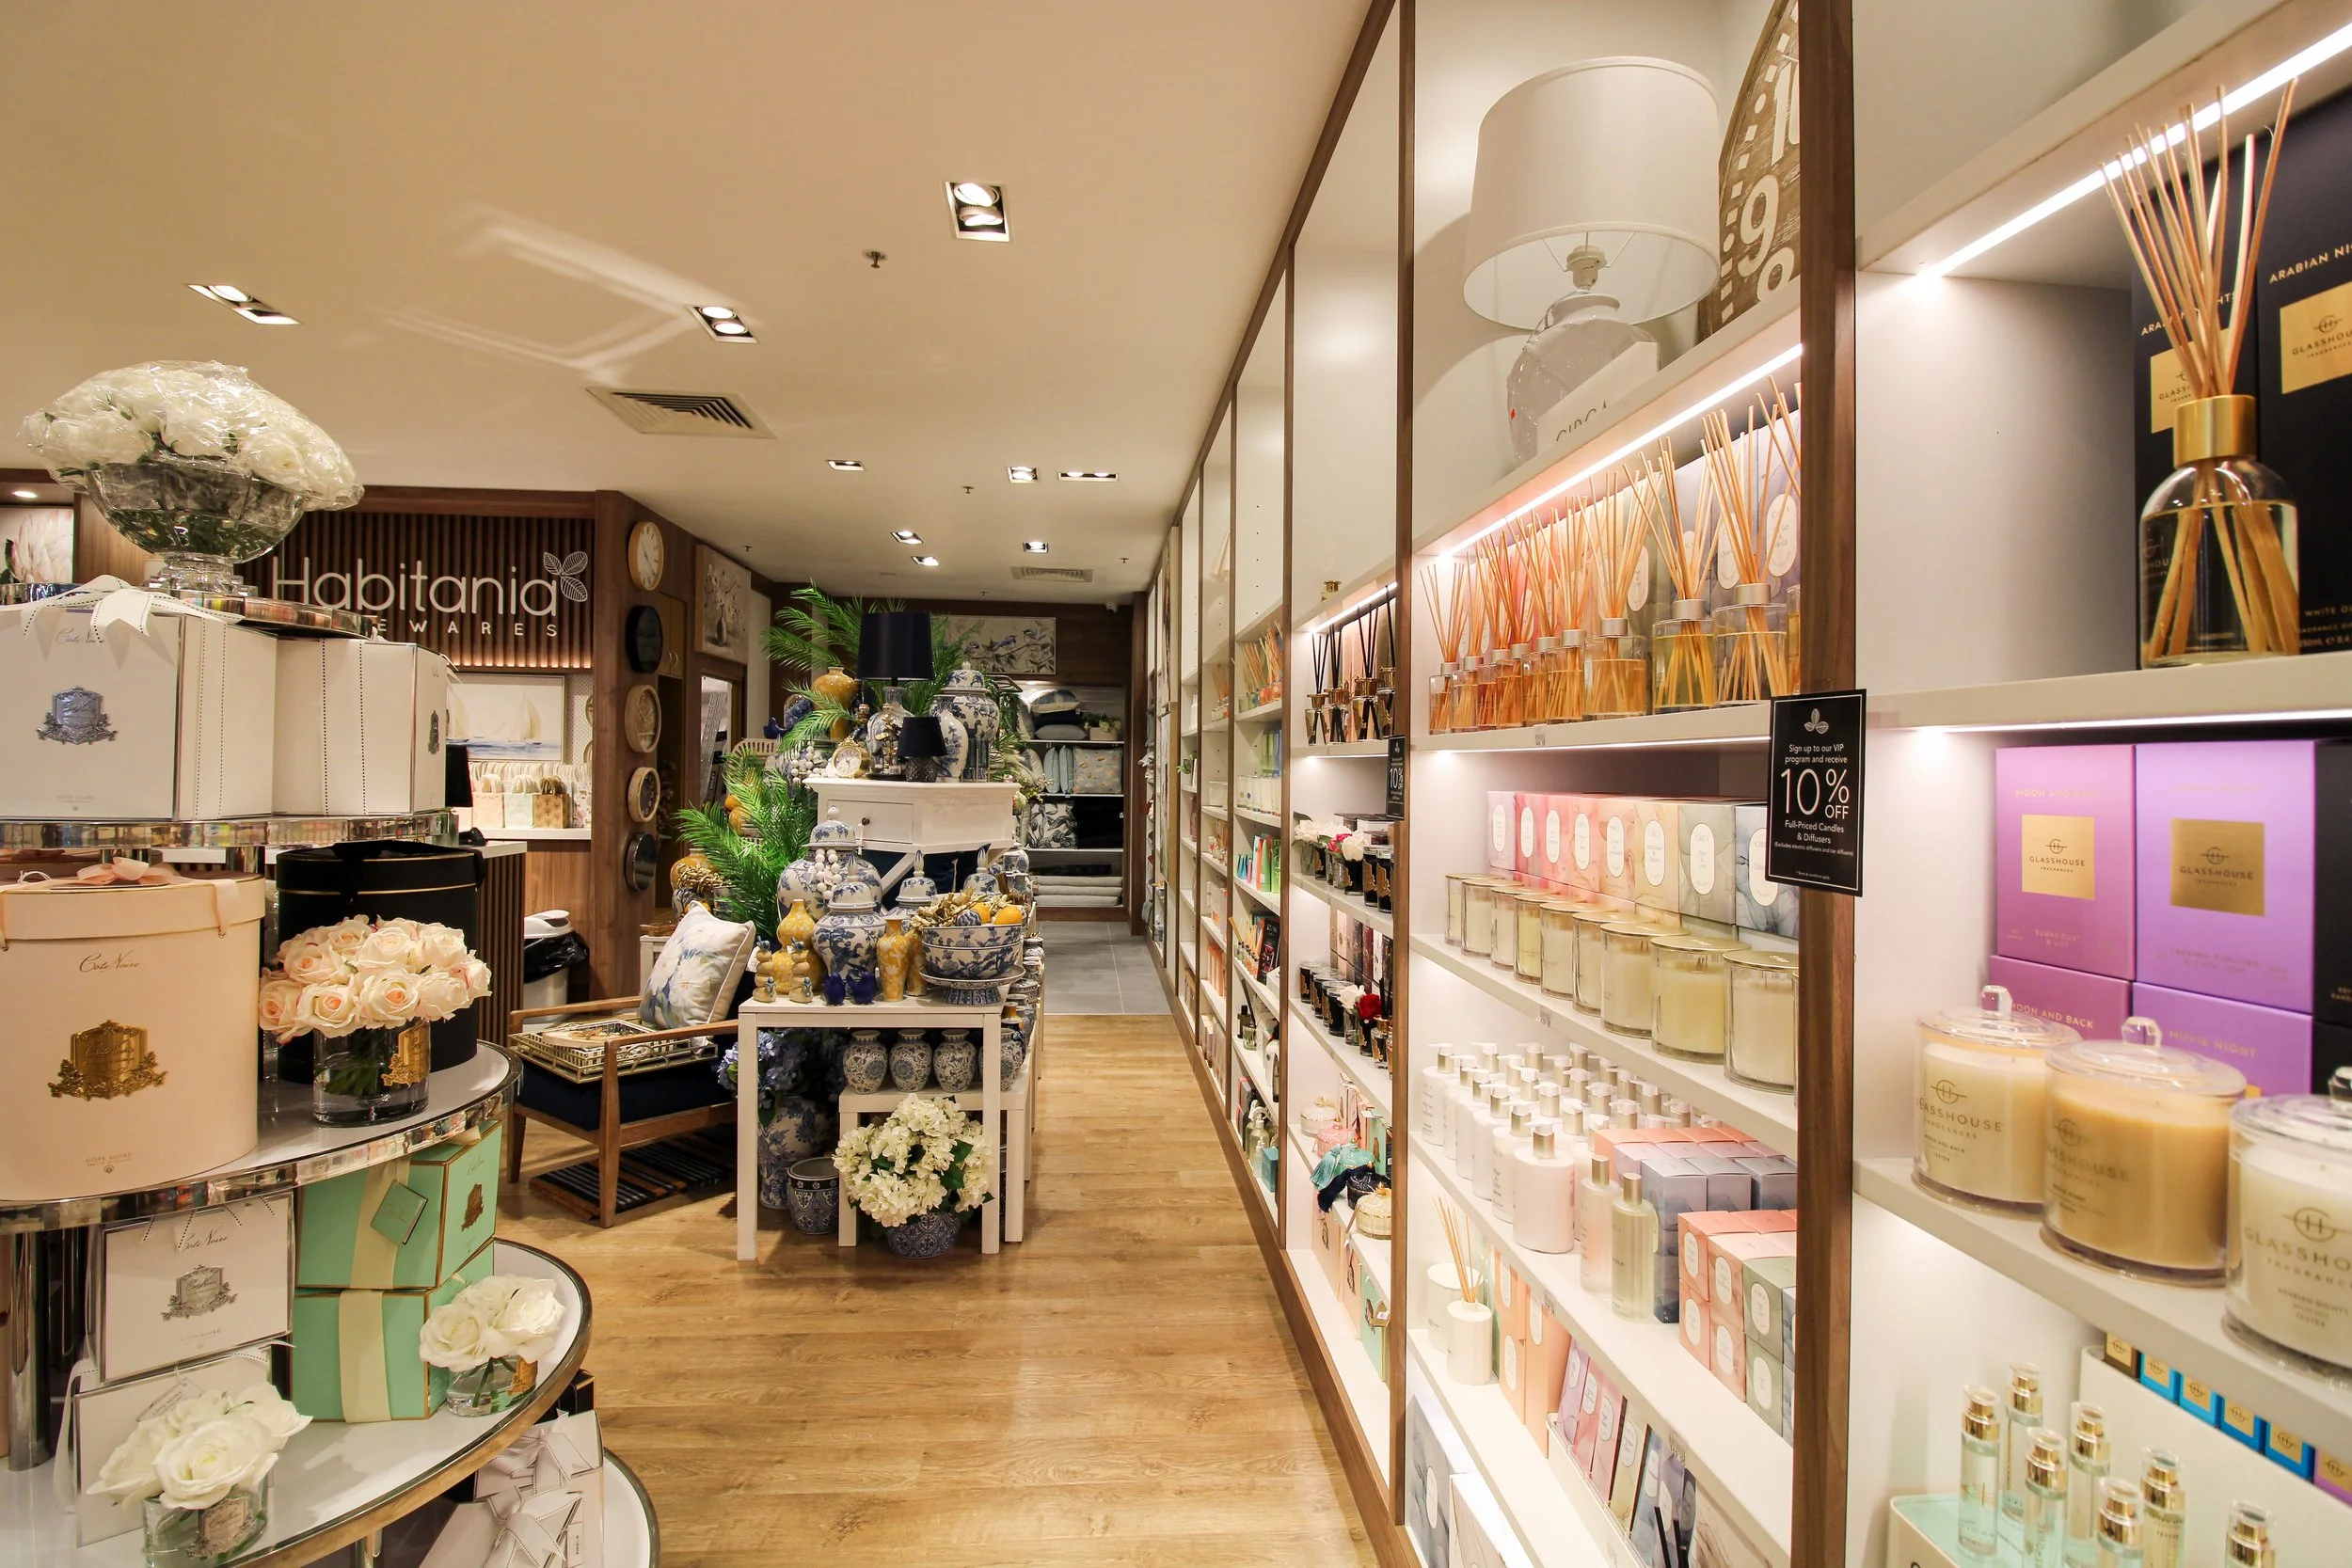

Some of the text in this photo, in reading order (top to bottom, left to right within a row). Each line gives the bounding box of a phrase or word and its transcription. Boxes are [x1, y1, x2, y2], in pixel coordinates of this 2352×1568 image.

[1738, 174, 1780, 277] 9
[2269, 251, 2328, 284] ARABIAN
[273, 556, 558, 616] Habitania
[1788, 743, 1802, 754] Sign
[1803, 746, 1812, 754] up
[1833, 743, 1844, 752] VIP
[1784, 754, 1848, 765] program and receive
[1781, 768, 1850, 816] 10%
[1825, 804, 1850, 819] OFF
[1785, 819, 1844, 833] Full-Priced Candles
[1796, 832, 1832, 844] & Diffusers
[2029, 856, 2085, 866] GLASSHOUSE
[2179, 865, 2254, 880] GLASSHOUSE
[2042, 1010, 2062, 1022] AND
[2066, 1015, 2094, 1030] BACK
[2215, 1039, 2257, 1058] NIGHT
